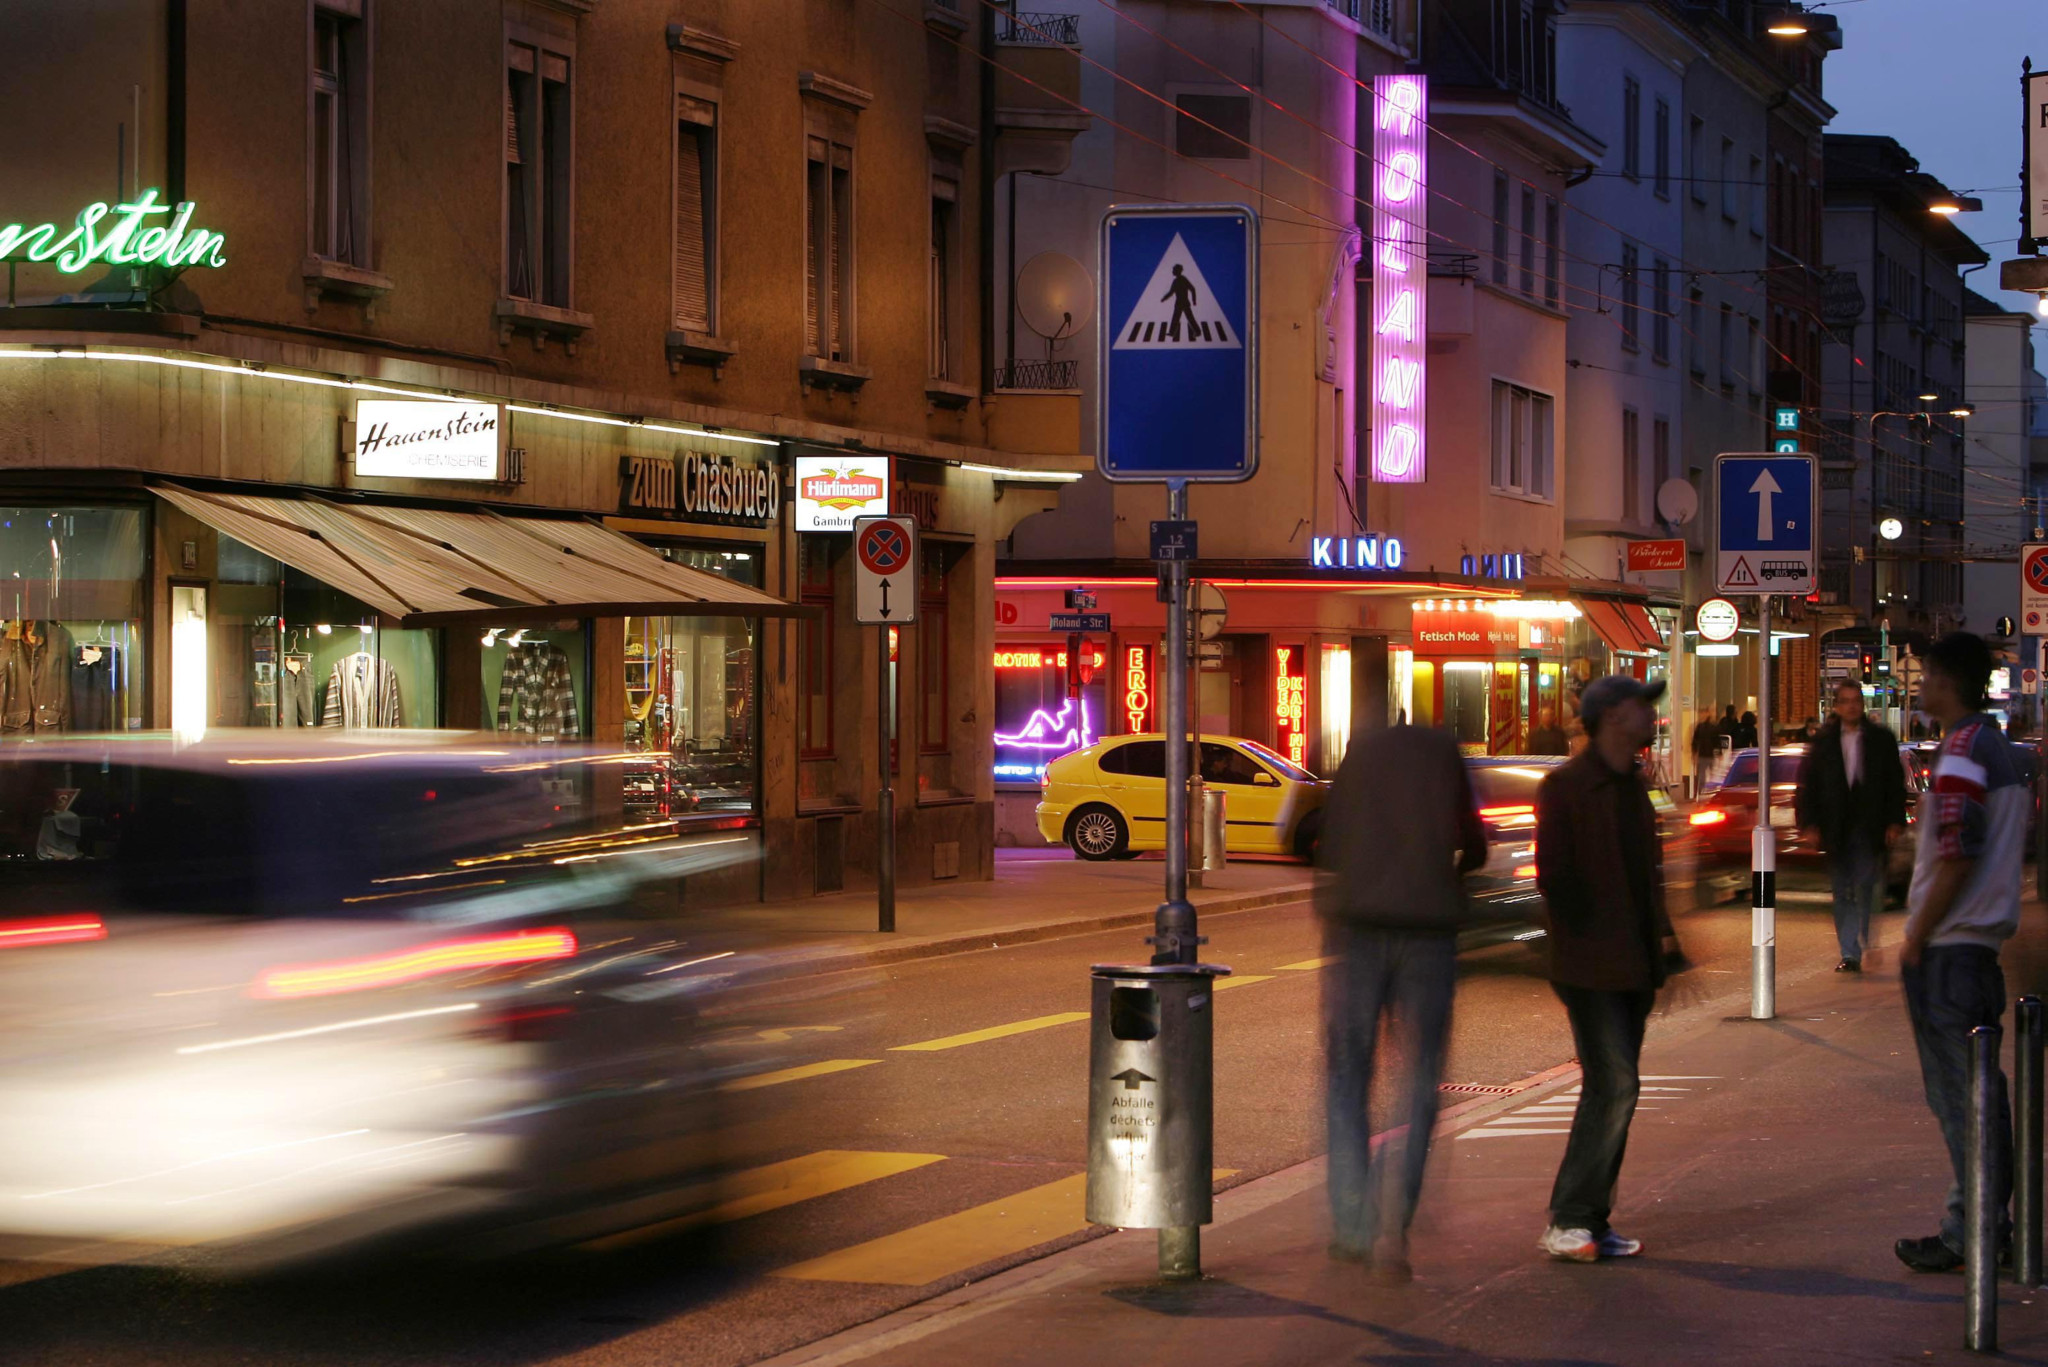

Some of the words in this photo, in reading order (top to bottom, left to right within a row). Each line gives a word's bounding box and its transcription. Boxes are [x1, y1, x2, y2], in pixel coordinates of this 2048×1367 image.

[1377, 80, 1419, 477] ROLAND
[359, 411, 496, 456] Hauenstein
[407, 453, 488, 468] CHEMISERIE
[629, 455, 676, 510] zum
[682, 449, 779, 519] Chäsbueb
[806, 480, 877, 497] Hürlimann
[1312, 536, 1402, 568] KINO
[1775, 569, 1788, 577] BUS
[1053, 617, 1080, 628] Roland
[1089, 618, 1104, 628] Str.
[1420, 631, 1455, 642] Fetisch
[1457, 632, 1480, 642] Mode
